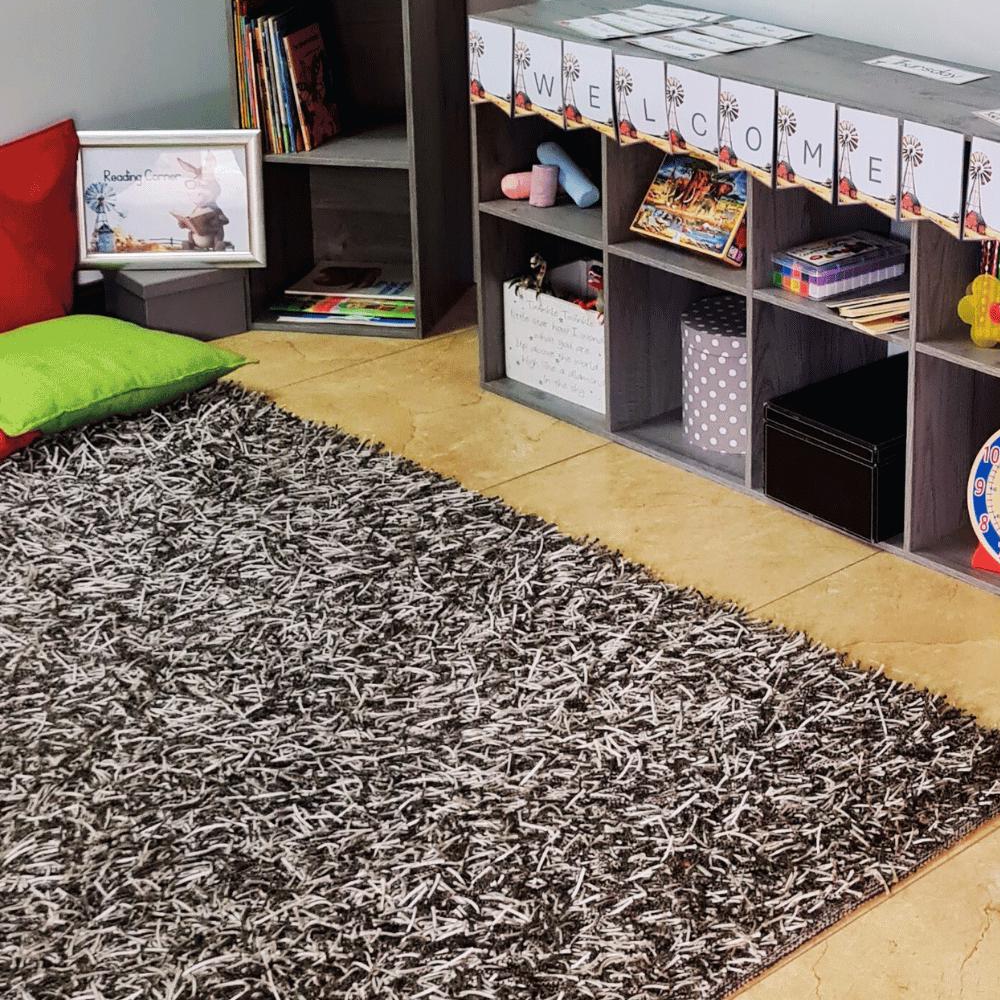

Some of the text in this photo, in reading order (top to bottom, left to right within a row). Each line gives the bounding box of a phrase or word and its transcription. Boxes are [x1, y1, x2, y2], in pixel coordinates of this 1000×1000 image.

[103, 168, 182, 187] Reading Corner
[983, 446, 1000, 464] 10
[975, 479, 985, 495] 9
[980, 515, 989, 533] 8
